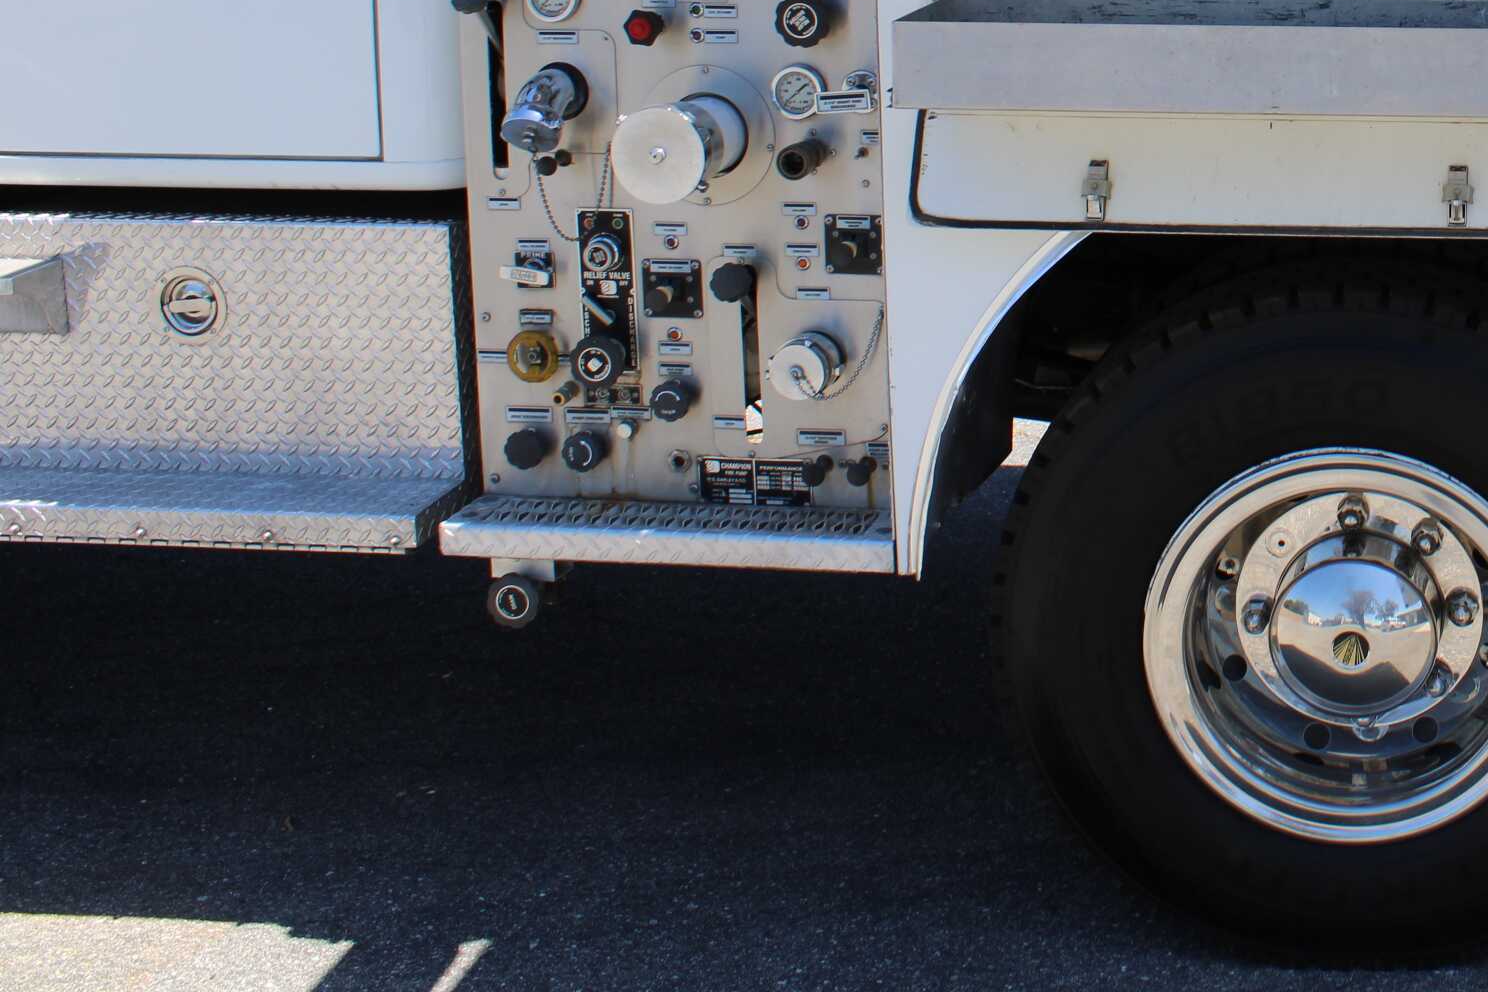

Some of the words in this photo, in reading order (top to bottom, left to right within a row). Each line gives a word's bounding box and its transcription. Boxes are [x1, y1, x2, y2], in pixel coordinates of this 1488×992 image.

[583, 271, 607, 280] RELIEF
[608, 271, 631, 280] VALVE
[720, 462, 752, 470] CHAMPION
